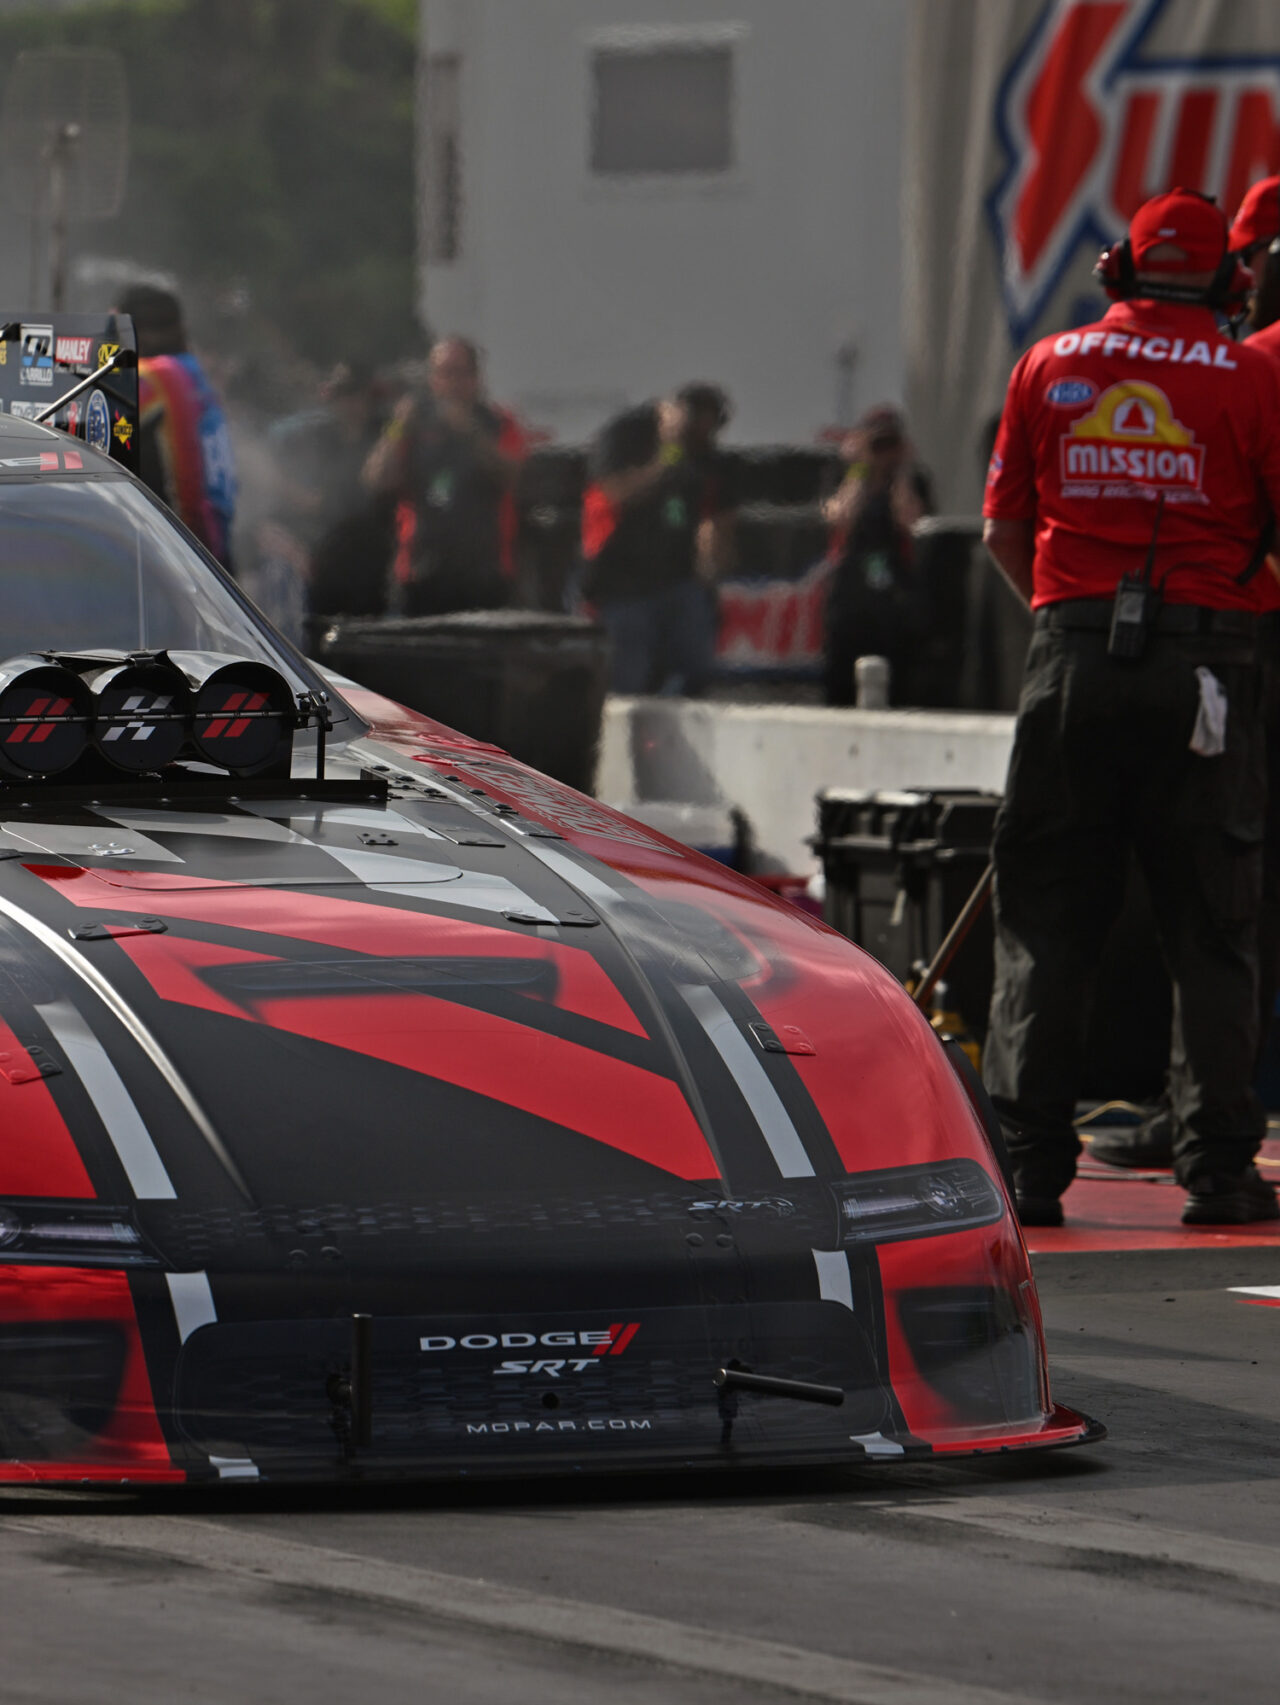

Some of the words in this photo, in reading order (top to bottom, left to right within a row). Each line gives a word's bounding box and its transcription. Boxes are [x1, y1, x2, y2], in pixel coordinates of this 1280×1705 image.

[56, 338, 91, 362] MANLEY
[1053, 331, 1238, 371] OFFICIAL
[419, 1330, 614, 1352] DODGE
[492, 1357, 601, 1378] SRT
[465, 1418, 652, 1435] MOPAR.COM
